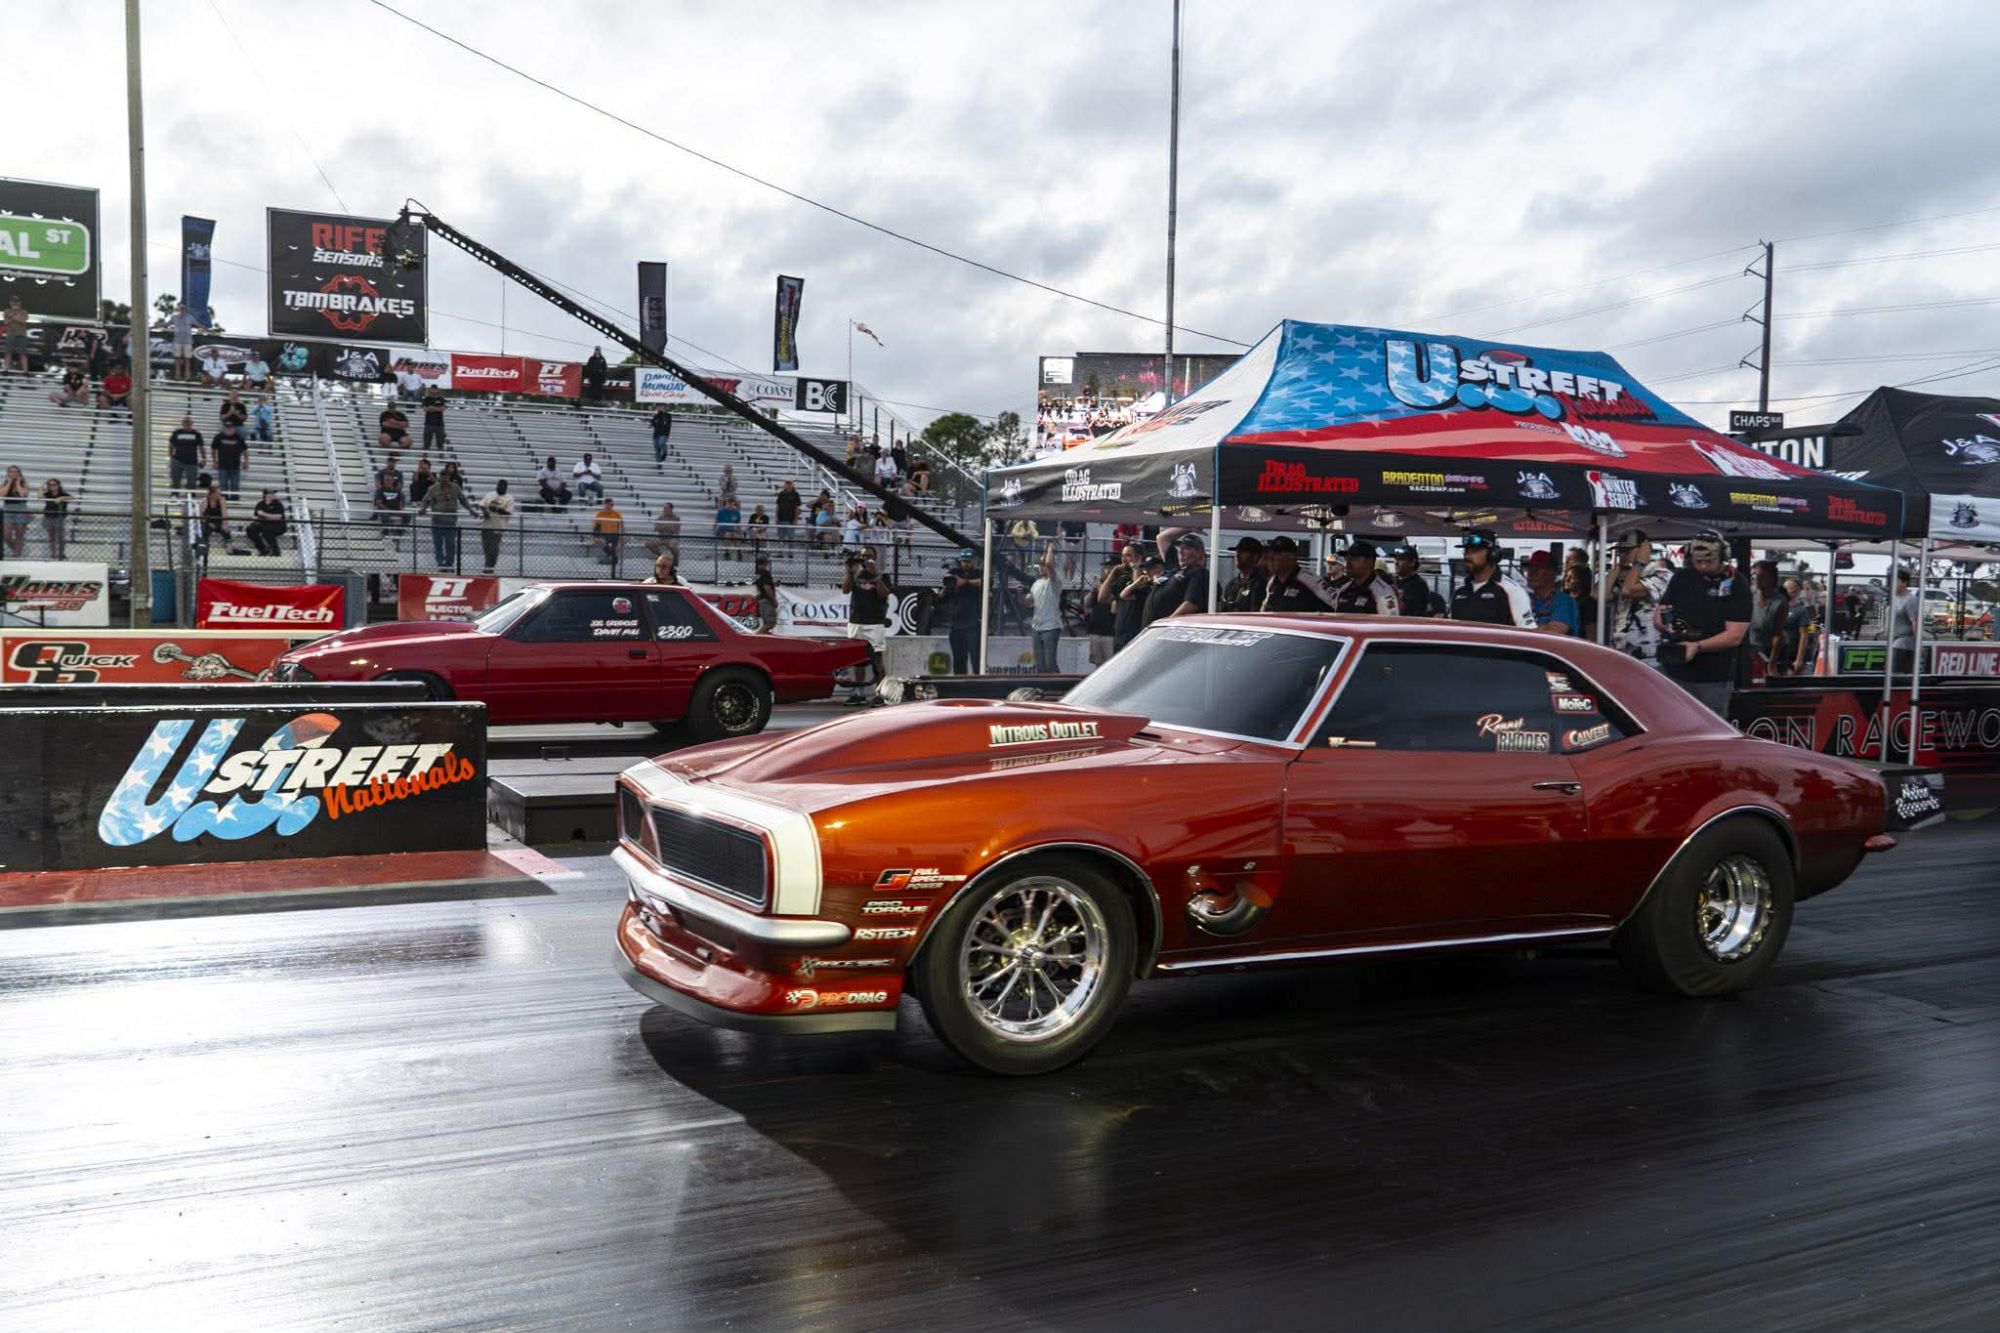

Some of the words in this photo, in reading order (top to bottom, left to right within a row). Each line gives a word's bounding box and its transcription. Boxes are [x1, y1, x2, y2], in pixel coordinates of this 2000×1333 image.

[46, 228, 72, 244] ST
[312, 223, 386, 254] RIFE
[312, 249, 384, 268] SENSORS
[336, 349, 379, 367] J&A
[455, 365, 519, 379] FuelTech
[1460, 358, 1624, 405] STREET
[1733, 415, 1770, 427] CHAPS
[1751, 435, 1826, 468] TON
[1170, 463, 1198, 481] J&A
[1264, 460, 1306, 476] DRAG
[1257, 473, 1359, 493] ILLUSTRATED
[1516, 470, 1555, 487] J&A
[207, 601, 335, 623] FuelTech
[657, 625, 693, 637] 2300
[1938, 653, 1966, 675] RED
[1968, 651, 1994, 674] LINE
[990, 724, 1048, 744] NITROUS
[1049, 720, 1098, 738] OUTLET
[204, 742, 454, 793] STREET
[322, 751, 476, 820] Nationals
